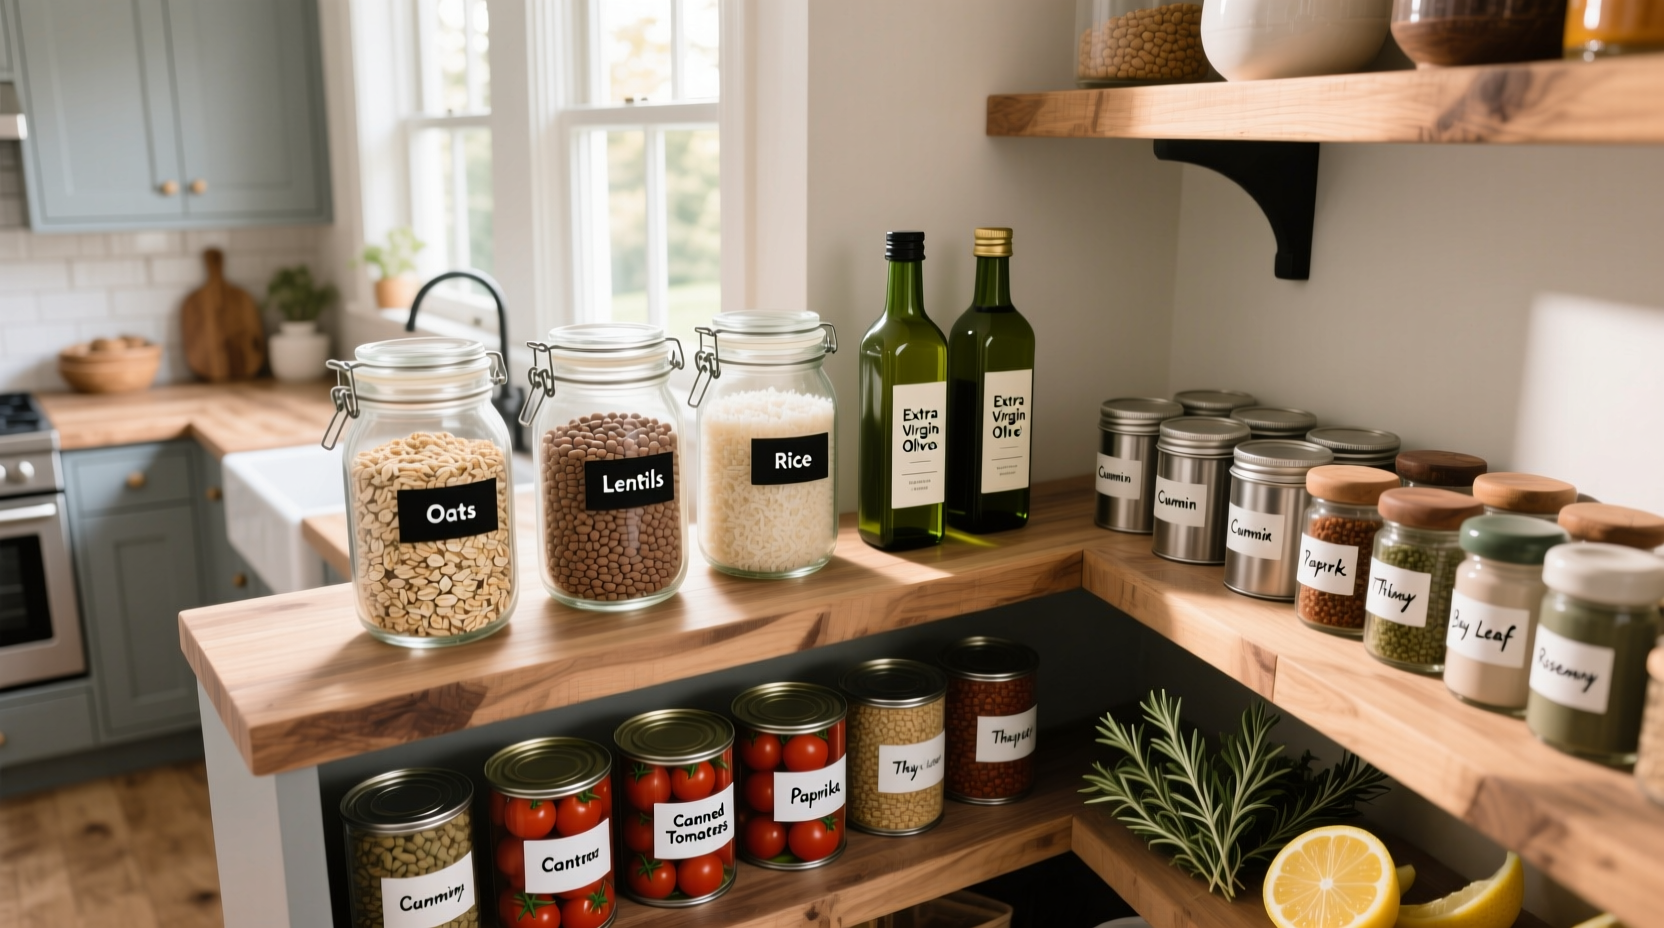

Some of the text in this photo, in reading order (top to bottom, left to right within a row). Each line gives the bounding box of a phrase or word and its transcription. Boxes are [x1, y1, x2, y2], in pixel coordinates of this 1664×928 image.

[994, 395, 1024, 408] Extra
[903, 408, 938, 422] Extra
[992, 408, 1026, 425] Virgin
[902, 422, 939, 439] Virgin
[774, 452, 813, 469] Rice
[602, 469, 664, 494] Lentils
[426, 502, 477, 524] Oats
[1475, 619, 1517, 653] Leaf
[790, 779, 841, 809] Paprika
[673, 801, 725, 828] Canned
